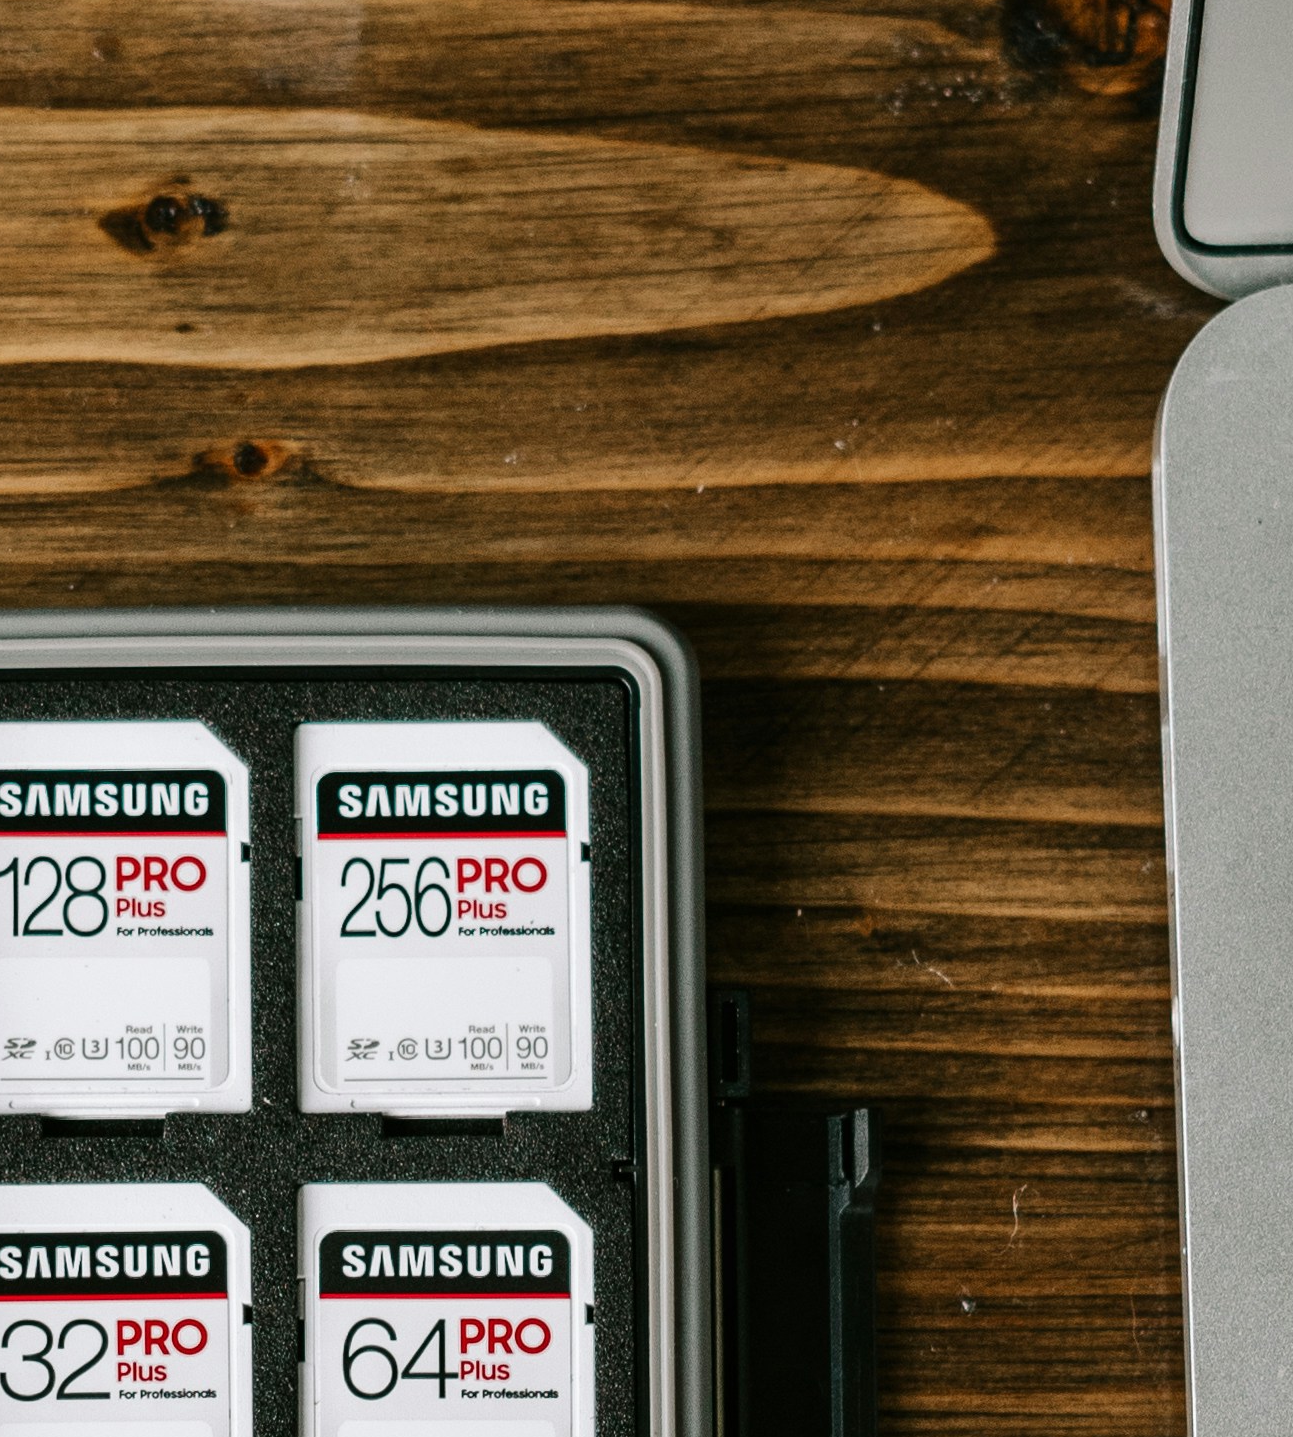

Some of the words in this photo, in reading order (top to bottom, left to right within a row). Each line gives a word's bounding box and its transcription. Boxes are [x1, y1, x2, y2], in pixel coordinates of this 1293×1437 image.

[338, 781, 549, 819] SAMSUNG
[115, 855, 207, 893] PRO
[116, 897, 166, 918] Plus
[340, 857, 452, 938] 256
[456, 856, 548, 894] PRO
[457, 898, 508, 920] Plus
[116, 926, 135, 937] For
[137, 925, 215, 937] Professionals
[458, 926, 477, 937] For
[478, 925, 556, 937] Professionals
[125, 1024, 153, 1035] Read
[175, 1024, 204, 1034] Write
[468, 1024, 496, 1035] Read
[518, 1024, 546, 1034] Write
[115, 1036, 160, 1061] 100
[173, 1036, 206, 1061] 90
[458, 1036, 503, 1060] 100
[515, 1035, 549, 1060] 90
[341, 1243, 553, 1279] SAMSUNG
[0, 1318, 111, 1402] 32
[116, 1318, 209, 1356] PRO
[341, 1317, 459, 1400] 64
[459, 1317, 552, 1355] PRO
[117, 1361, 168, 1383] Plus
[460, 1359, 511, 1381] Plus
[118, 1389, 138, 1400] For
[139, 1387, 218, 1400] Professionals
[460, 1388, 480, 1399] For
[481, 1387, 560, 1400] Professionals
